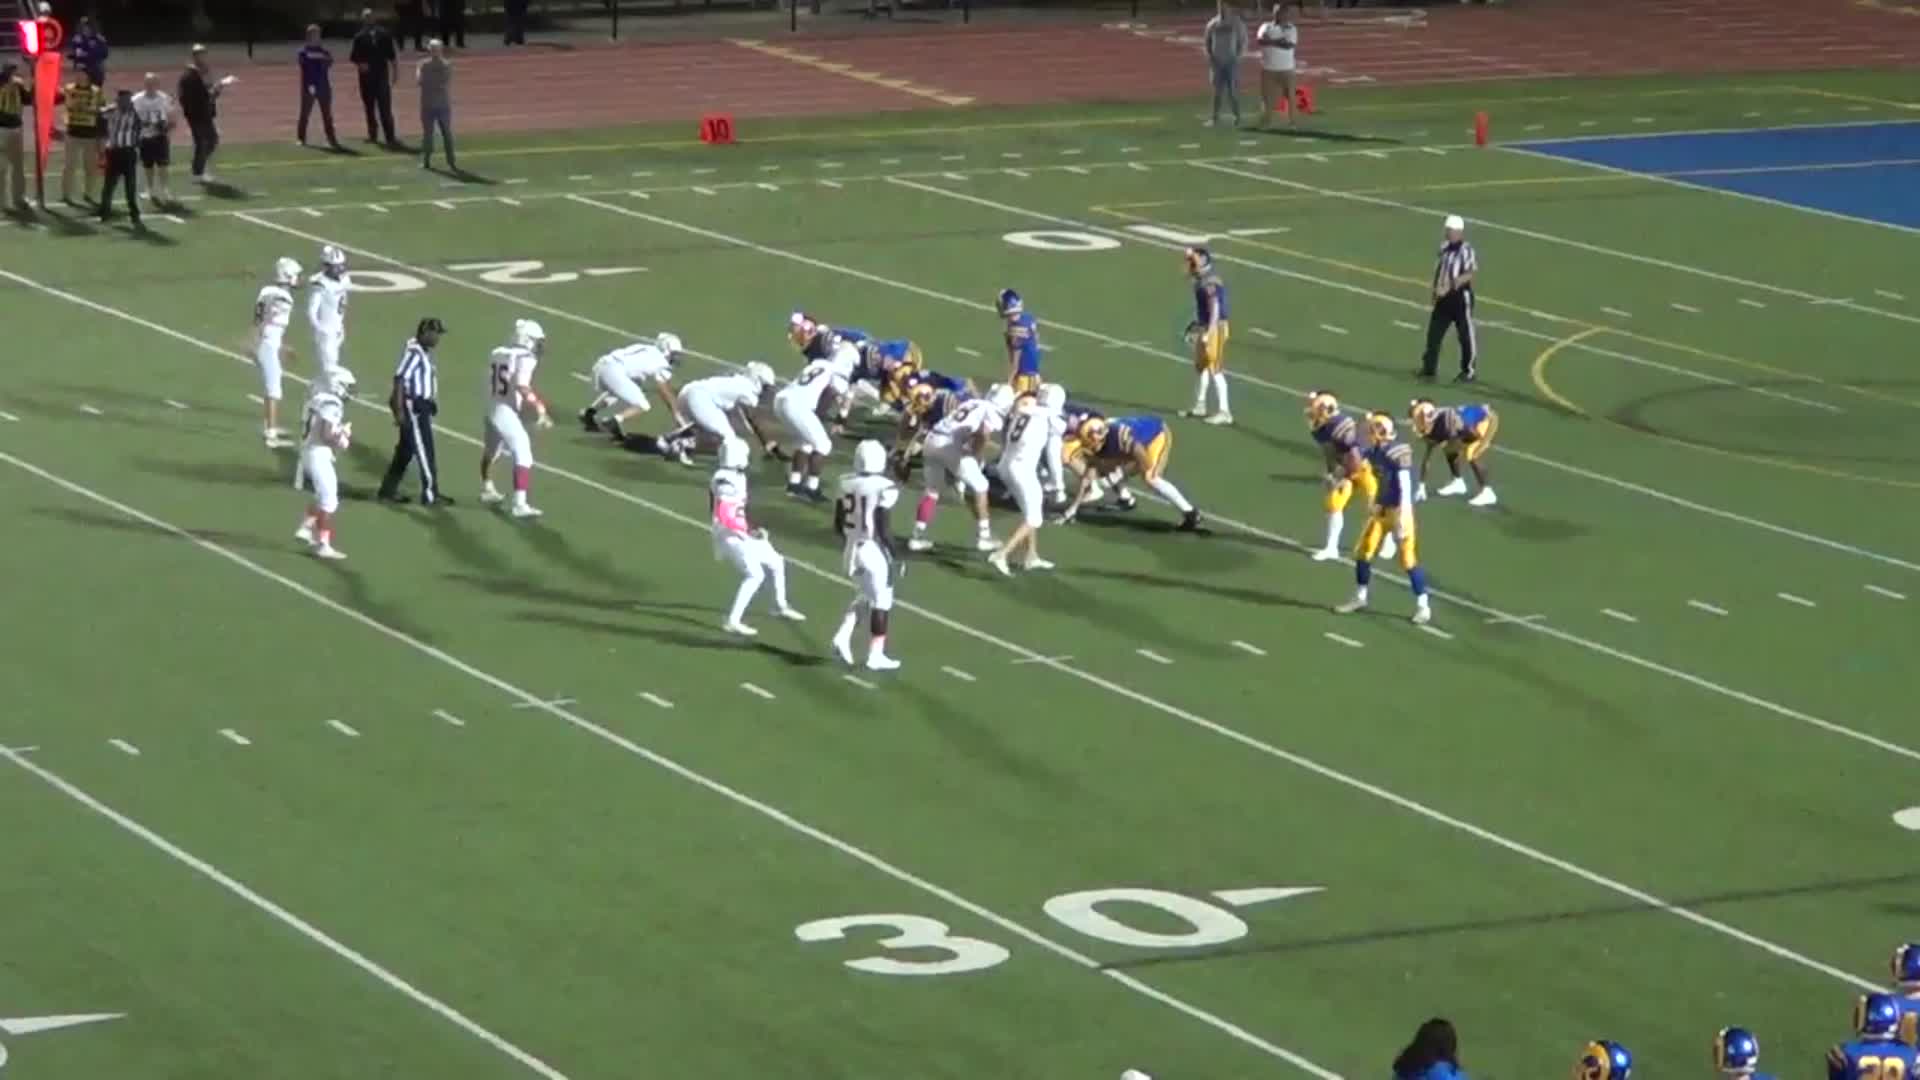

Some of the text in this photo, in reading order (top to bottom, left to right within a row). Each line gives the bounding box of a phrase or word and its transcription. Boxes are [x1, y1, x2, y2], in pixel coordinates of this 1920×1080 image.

[708, 117, 730, 141] 10
[491, 362, 510, 396] 15
[840, 493, 868, 530] 21
[794, 887, 1249, 975] 30
